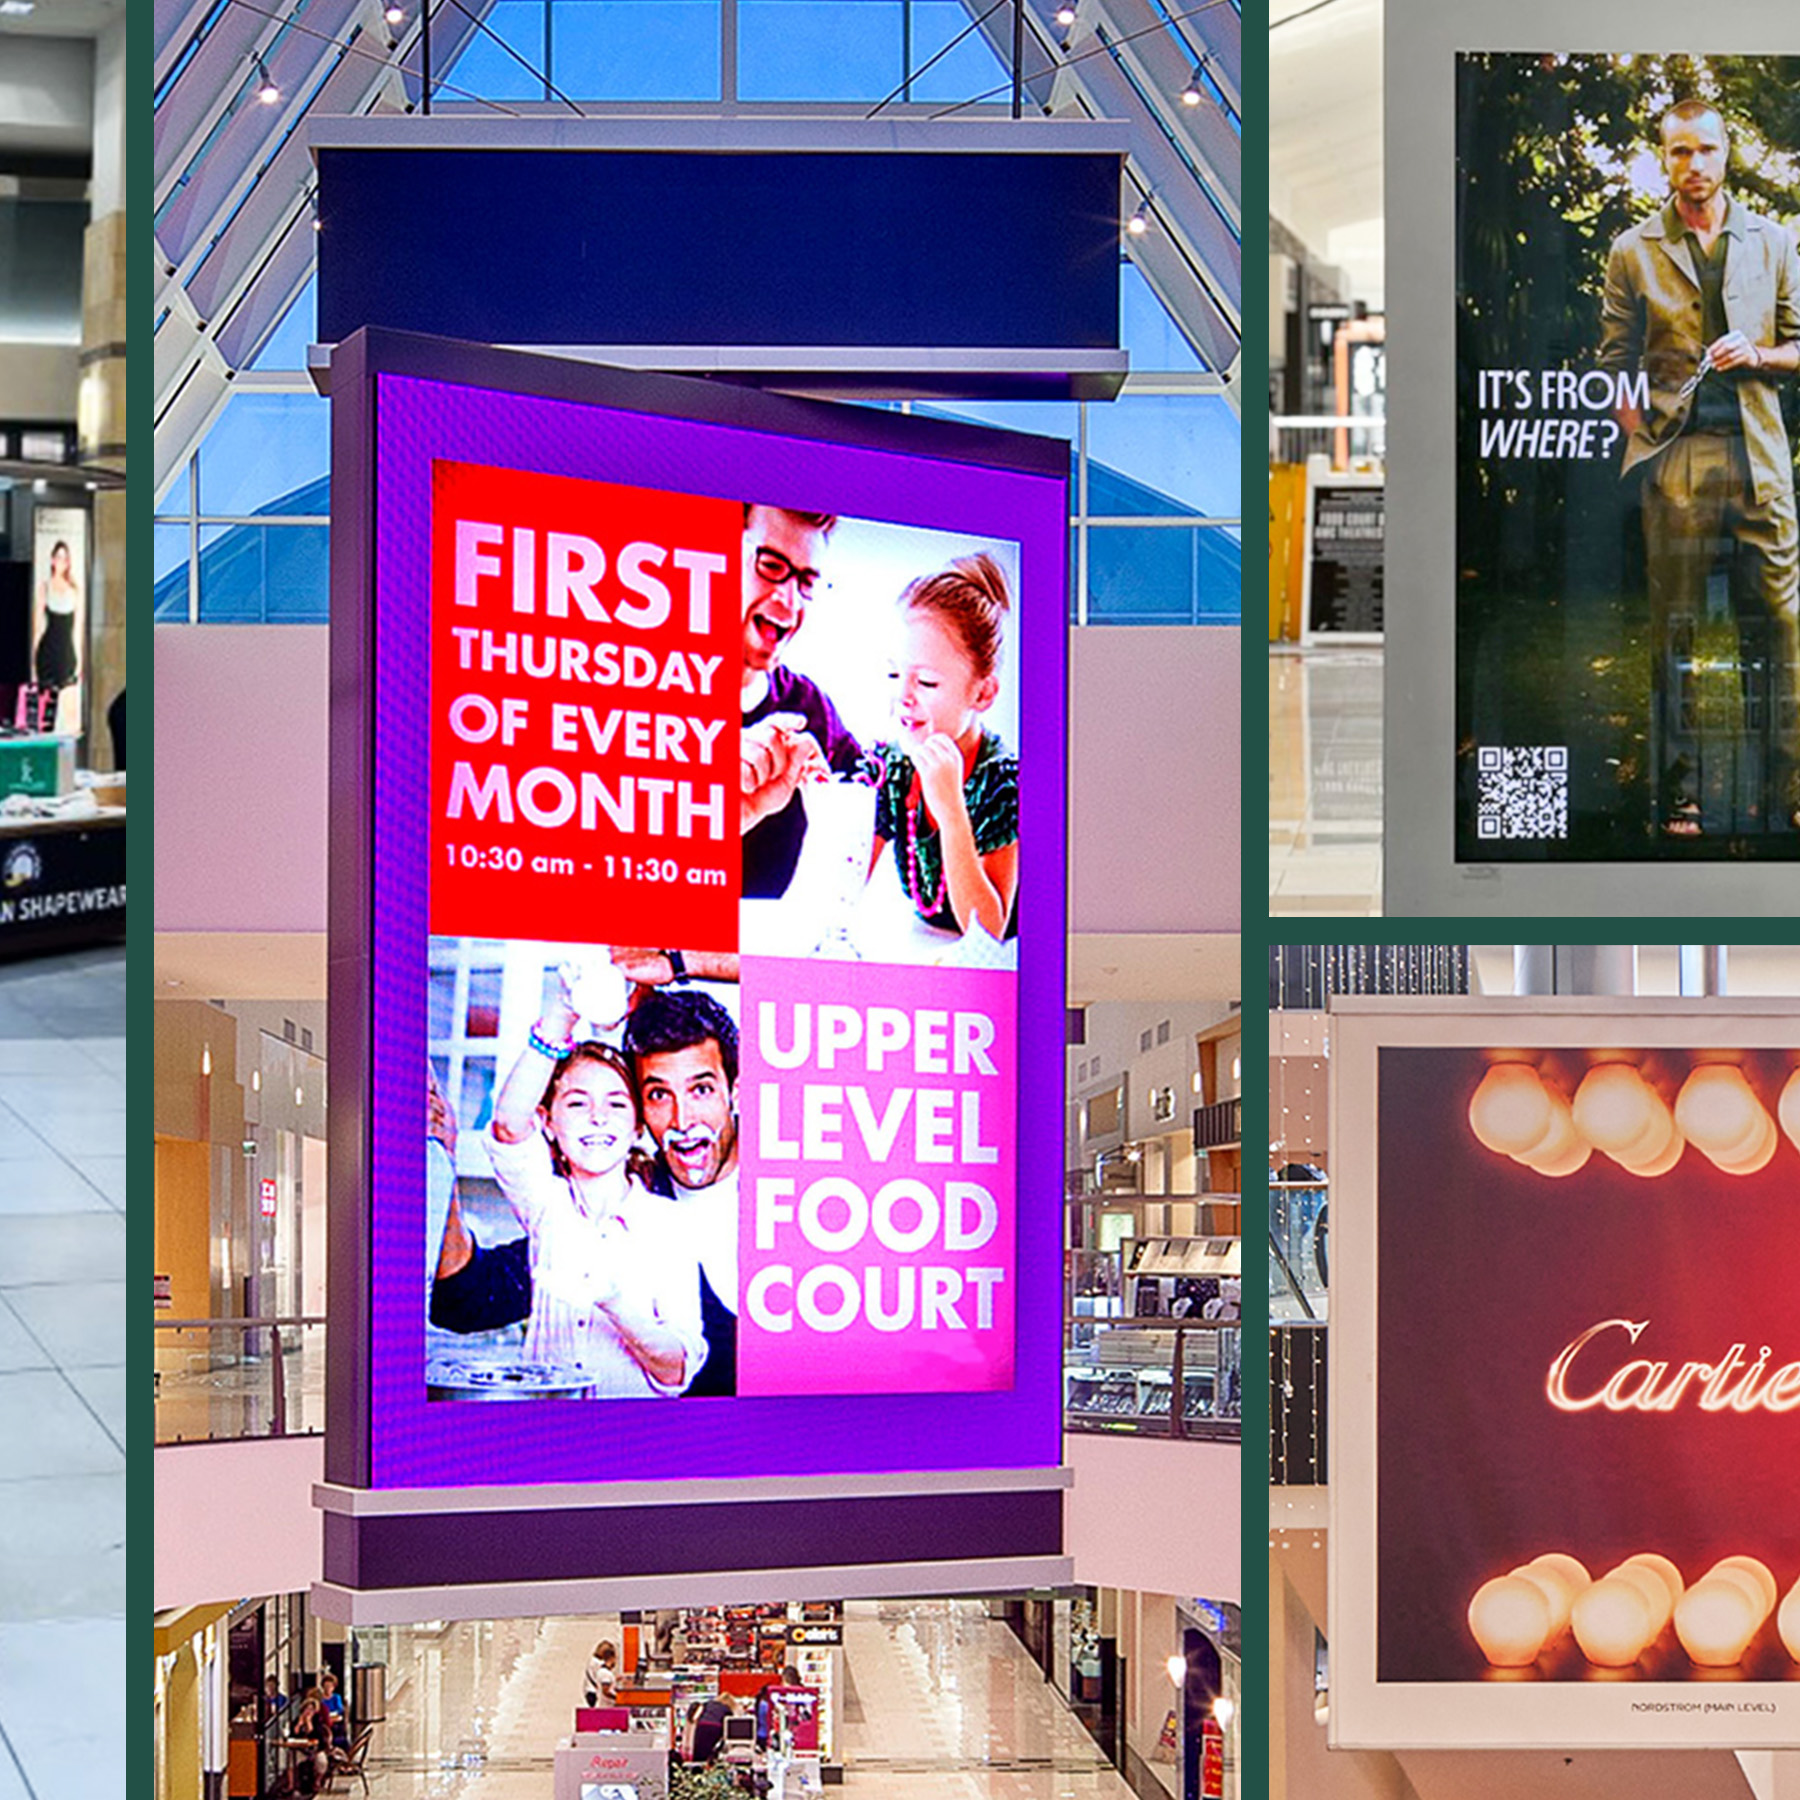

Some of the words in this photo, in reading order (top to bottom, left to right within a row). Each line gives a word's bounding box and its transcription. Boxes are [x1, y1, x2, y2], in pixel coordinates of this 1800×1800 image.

[1479, 369, 1532, 410] IT'S
[1541, 370, 1651, 411] FROM
[1480, 418, 1620, 459] WHERE?
[455, 519, 727, 635] FIRST
[451, 626, 724, 695] THURSDAY
[449, 693, 529, 746] OF
[552, 703, 727, 765] EVERY
[446, 761, 725, 840] MONTH
[446, 843, 523, 872] 10:30
[531, 855, 574, 875] am
[604, 855, 678, 882] 11:30
[686, 867, 726, 886] am
[758, 1001, 999, 1076] UPPER
[758, 1082, 999, 1164] LEVEL
[755, 1177, 998, 1253] FOOD
[746, 1264, 1005, 1333] COURT
[1630, 1702, 1702, 1713] NORDSTROM
[1704, 1702, 1735, 1714] (MAIN
[1737, 1702, 1776, 1714] LEVEL)
